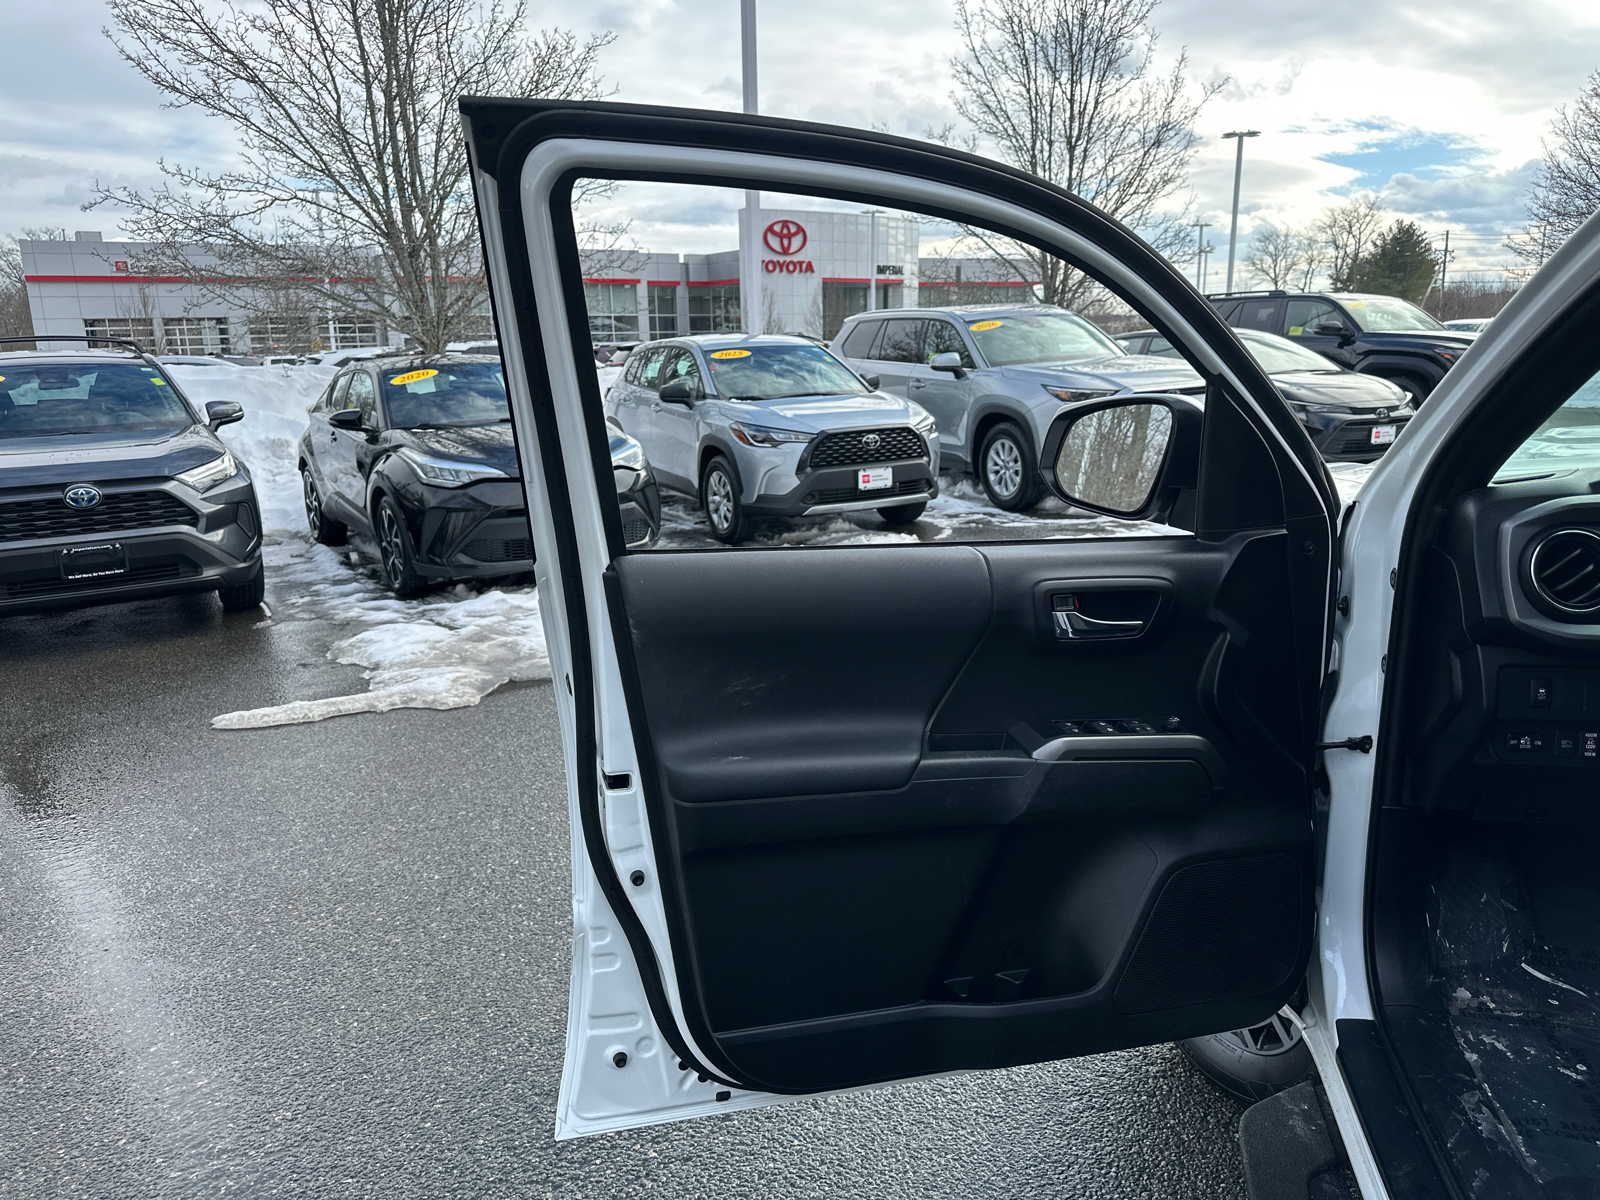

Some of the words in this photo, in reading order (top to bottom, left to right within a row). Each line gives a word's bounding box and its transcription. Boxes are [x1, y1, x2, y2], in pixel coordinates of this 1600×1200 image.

[876, 264, 904, 275] IMPERIAL
[718, 350, 743, 358] 2025
[399, 370, 429, 383] 2020
